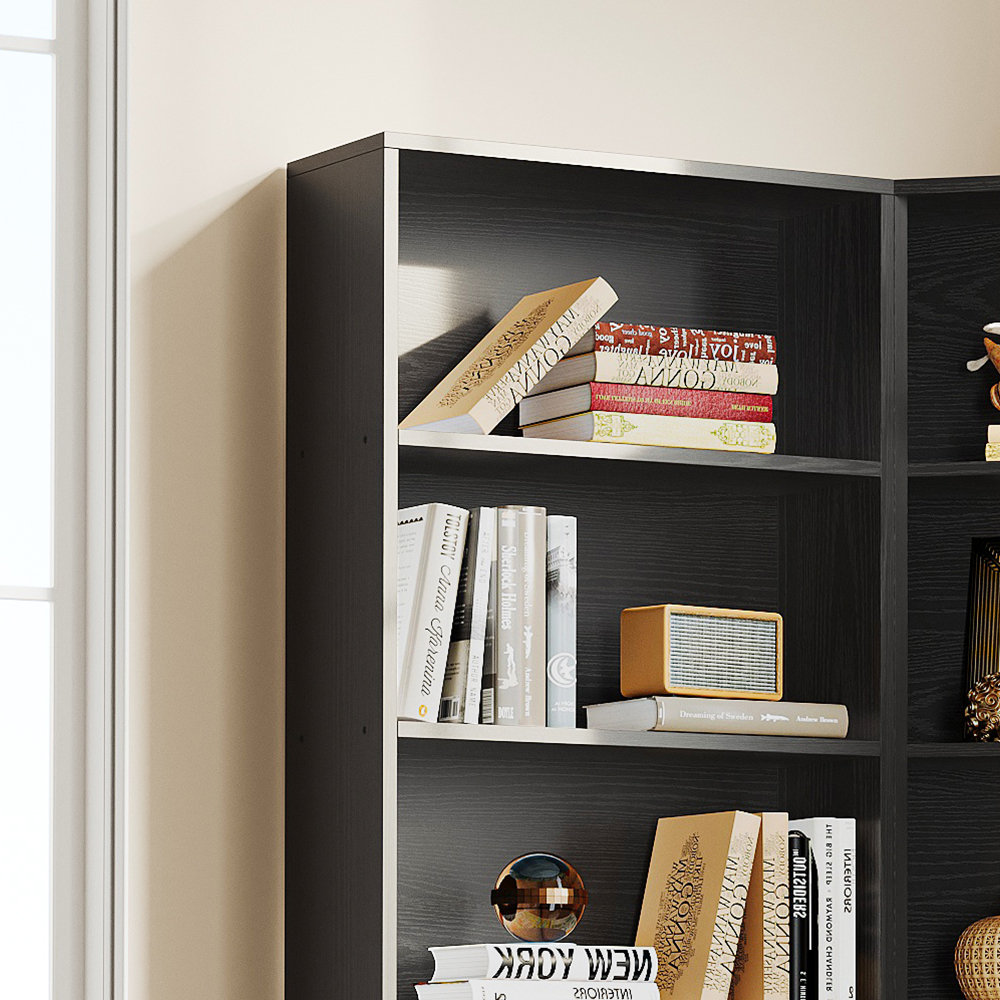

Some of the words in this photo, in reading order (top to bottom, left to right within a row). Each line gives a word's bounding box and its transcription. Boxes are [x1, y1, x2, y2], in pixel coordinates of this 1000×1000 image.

[440, 513, 462, 561] TOLSTOY
[433, 565, 452, 613] Anna
[500, 545, 517, 590] Sherlock
[501, 592, 516, 630] Holmes
[420, 617, 444, 697] Karenina
[679, 710, 716, 721] Dreaming
[725, 711, 754, 721] Sweden
